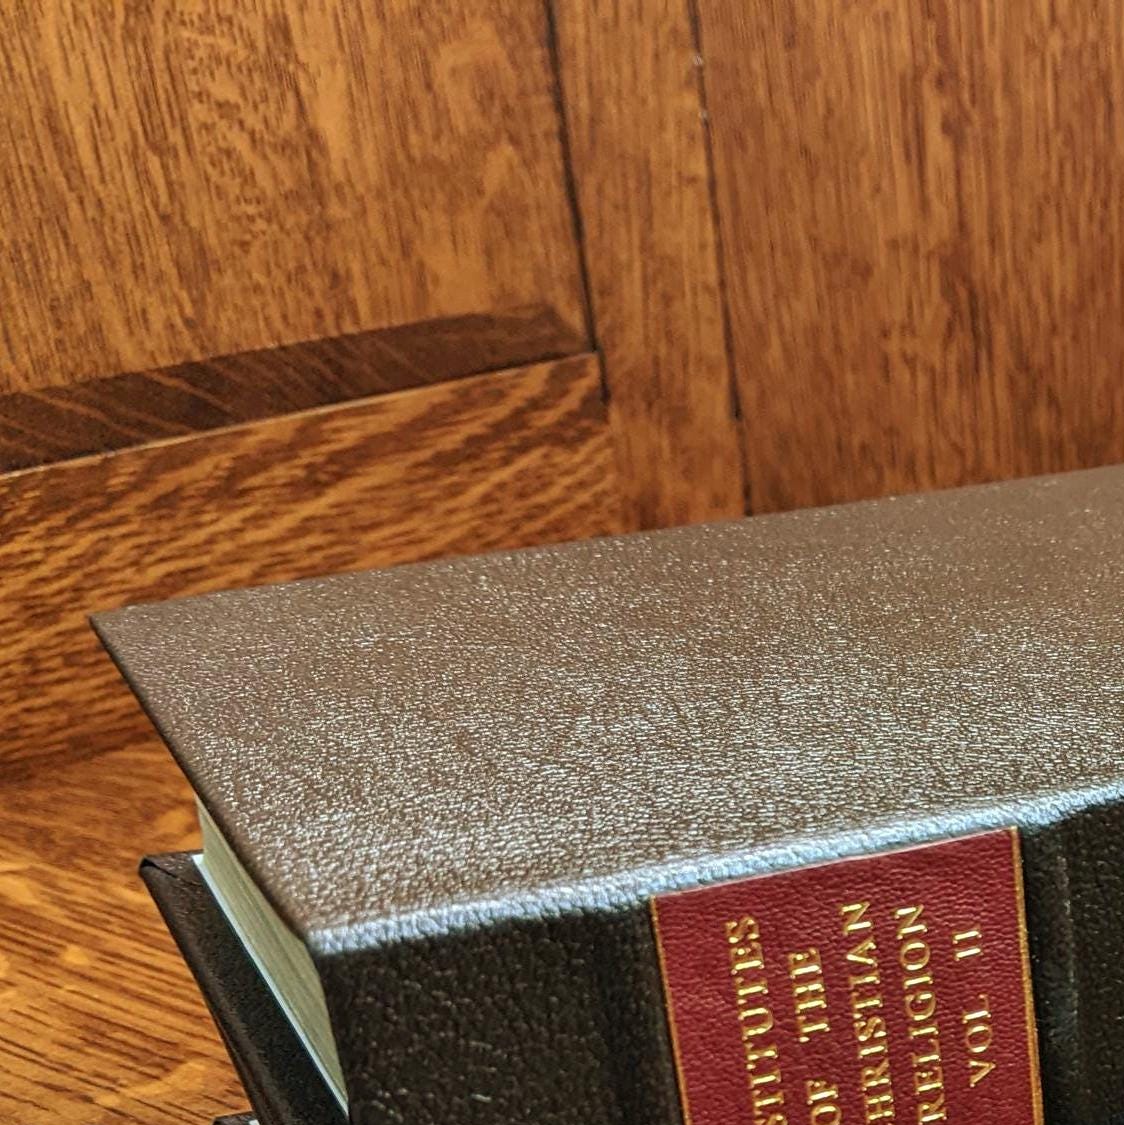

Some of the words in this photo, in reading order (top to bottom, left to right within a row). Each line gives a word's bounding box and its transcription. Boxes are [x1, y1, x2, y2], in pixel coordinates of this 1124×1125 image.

[952, 928, 982, 961] II
[788, 947, 830, 1043] THE
[894, 904, 947, 1125] RELIGION
[962, 994, 996, 1088] VOL
